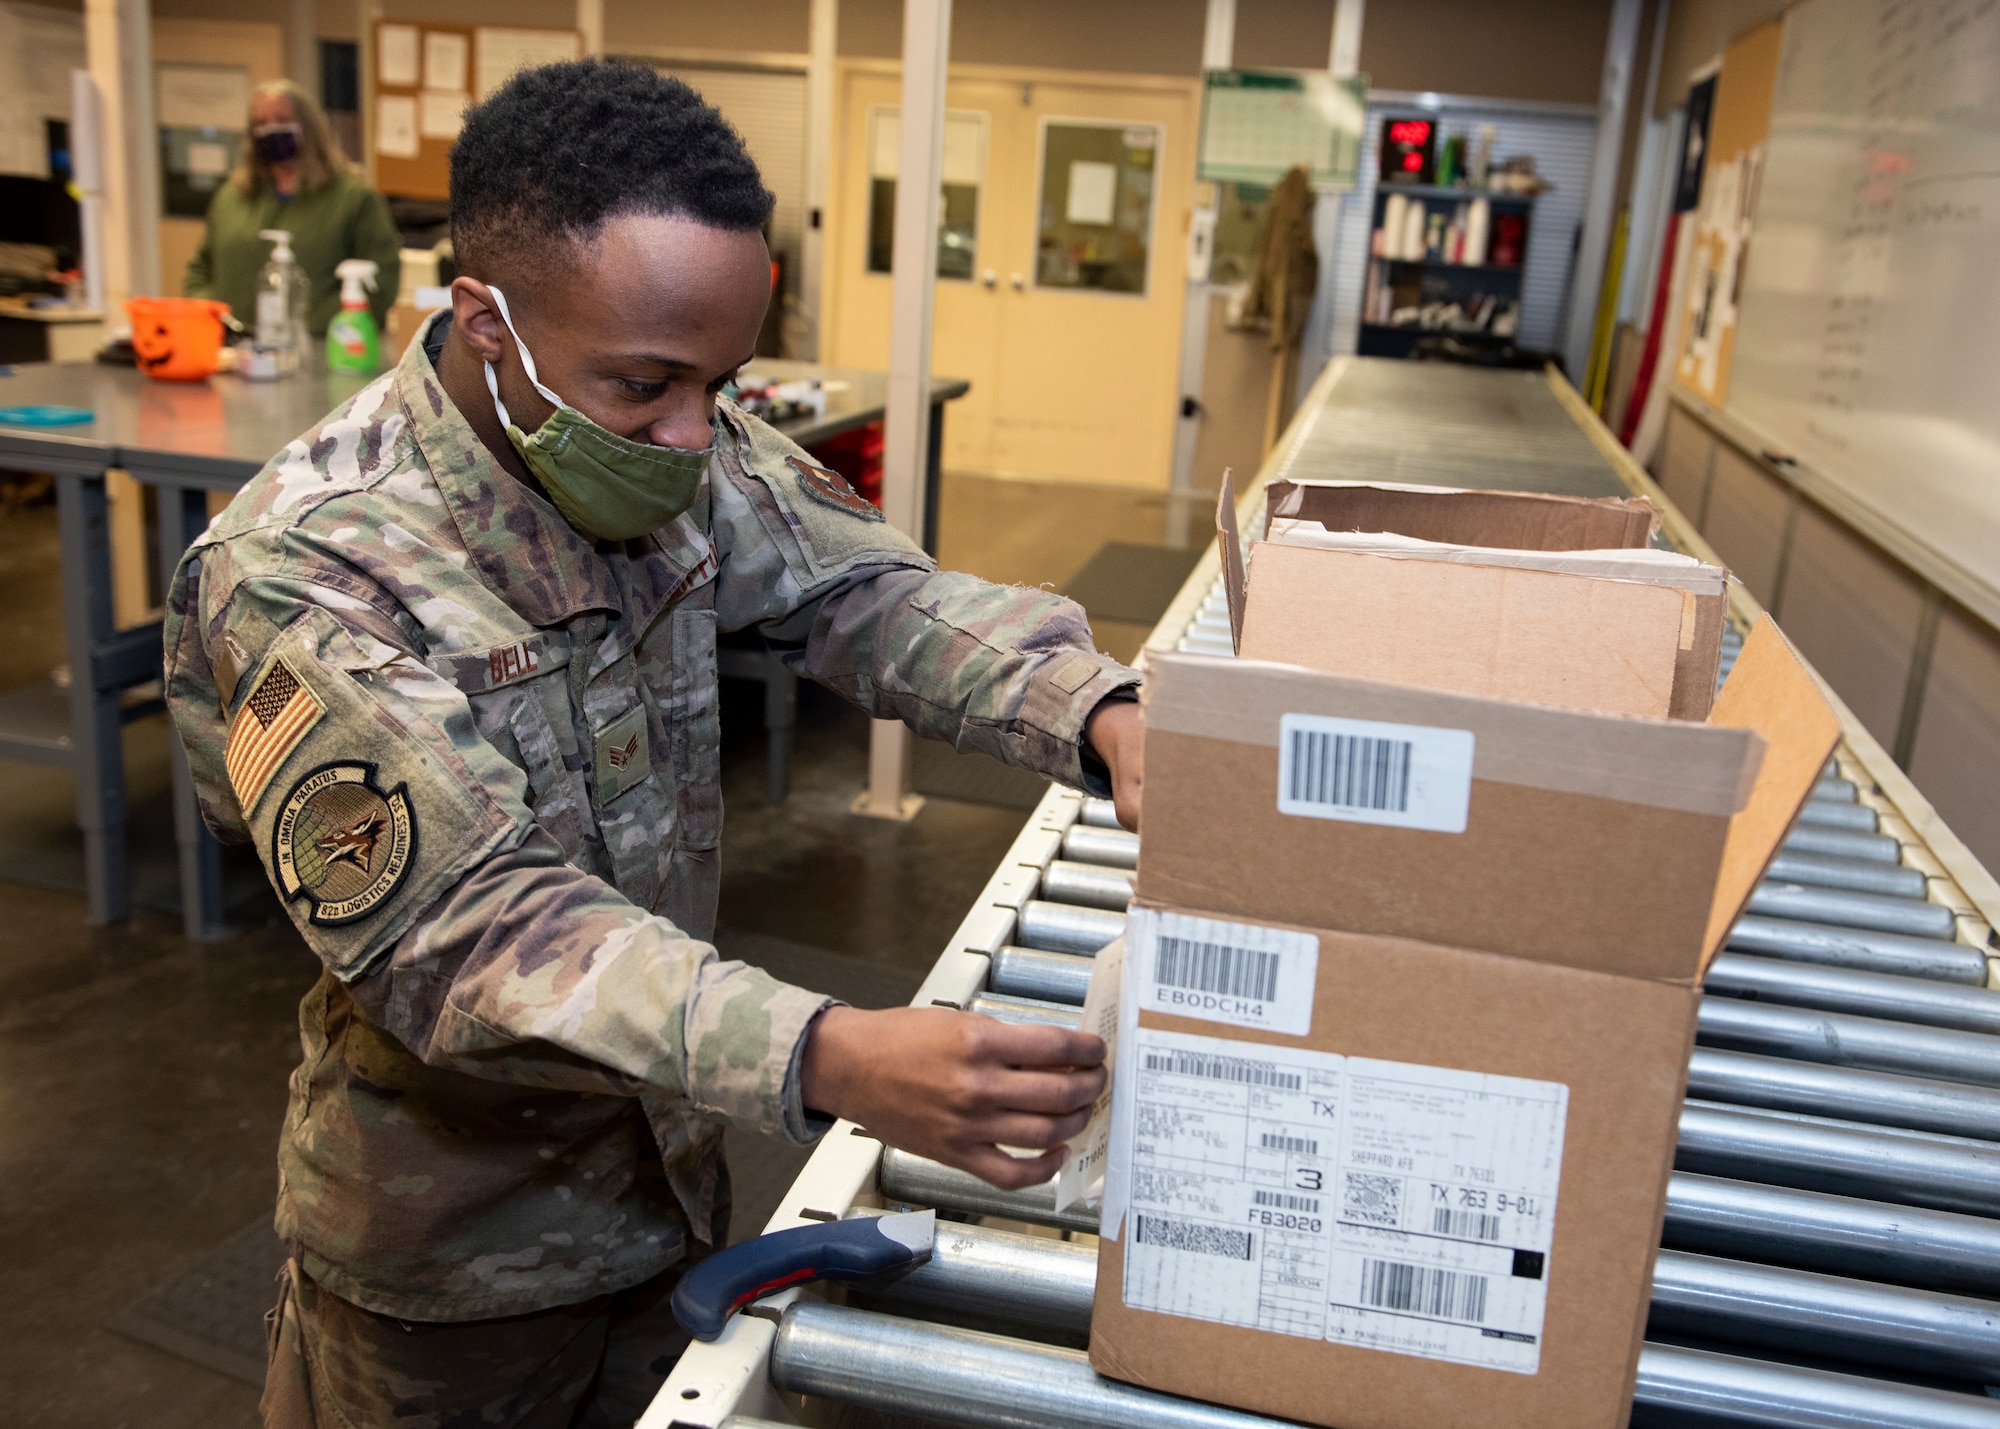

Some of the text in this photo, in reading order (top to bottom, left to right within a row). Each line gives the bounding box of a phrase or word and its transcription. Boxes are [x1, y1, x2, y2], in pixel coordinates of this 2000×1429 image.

[489, 641, 538, 685] BELL
[281, 770, 338, 865] IN OMNIA PARATUS
[342, 877, 391, 914] LOGISTICS
[388, 814, 407, 876] READINESS
[1311, 1100, 1335, 1118] TX
[1351, 1150, 1394, 1169] SHEPPARD
[1296, 1168, 1322, 1190] 3
[1430, 1183, 1449, 1204] TX
[1249, 1208, 1322, 1233] FB3020
